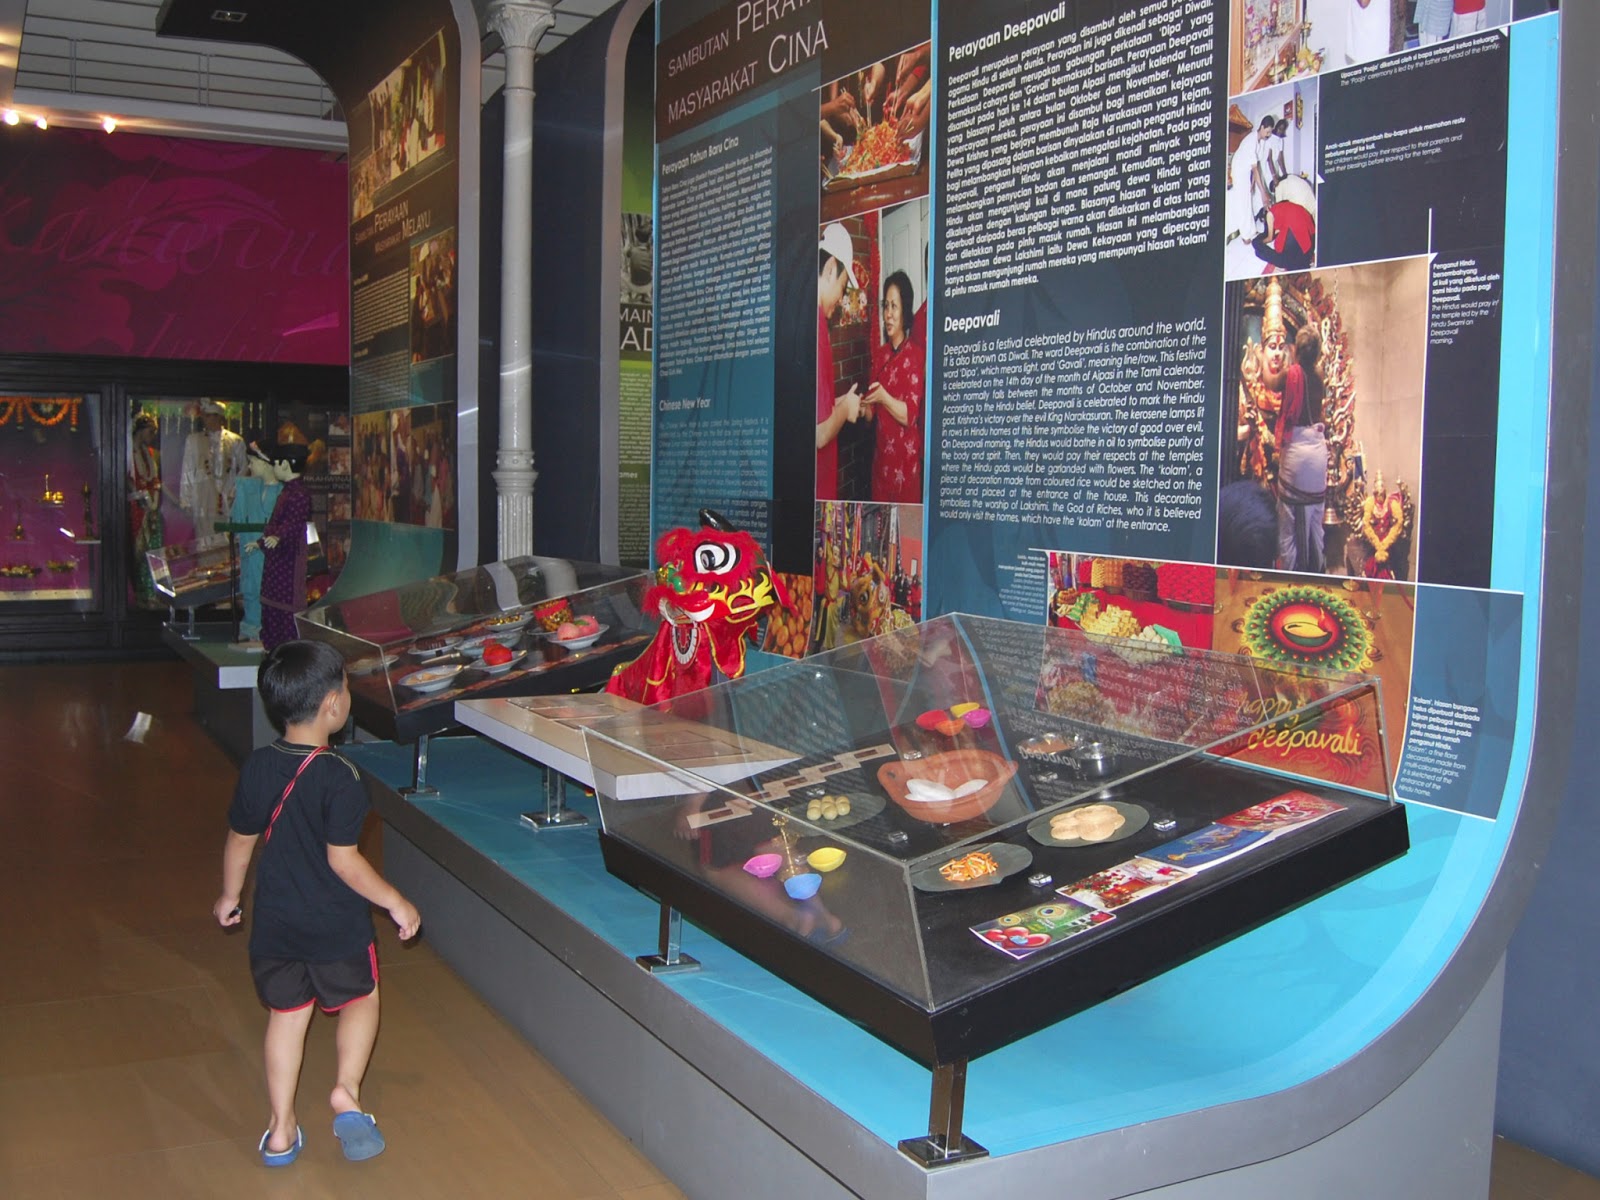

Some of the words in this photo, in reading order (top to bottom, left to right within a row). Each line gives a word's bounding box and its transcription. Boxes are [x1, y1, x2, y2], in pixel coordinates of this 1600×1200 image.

[668, 29, 729, 77] SAMBUTAN
[736, 0, 810, 40] PERA
[950, 32, 1000, 62] Perayaan
[1004, 2, 1065, 40] Deepavali
[668, 61, 758, 124] MASYARAKAT
[768, 20, 829, 73] CINA
[948, 93, 978, 108] Perkataan
[983, 78, 1015, 97] Deepavali
[1021, 65, 1060, 84] merupakan
[1066, 50, 1104, 71] gabungan
[1111, 33, 1152, 56] perkataan
[1191, 12, 1213, 29] yang
[948, 102, 981, 120] bermaksud
[983, 95, 1007, 109] cahaya
[1009, 90, 1022, 100] dan
[1052, 64, 1092, 86] bermaksud
[1095, 57, 1124, 72] barisan.
[1128, 43, 1166, 62] Perayaan
[1169, 24, 1213, 48] Deepavali
[947, 157, 964, 168] Dewa
[967, 150, 988, 162] Krishna
[991, 144, 1007, 157] yang
[1010, 136, 1036, 150] berjaya
[1039, 122, 1078, 141] membunuh
[1082, 117, 1099, 129] Raja
[1102, 103, 1152, 124] Narakasuran
[1156, 96, 1178, 111] yang
[1182, 87, 1211, 102] kejam.
[948, 138, 988, 155] kepercayaan
[991, 129, 1017, 143] mereka,
[1021, 118, 1053, 136] perayaan
[1068, 102, 1103, 120] disambut
[1107, 95, 1124, 109] bagi
[1128, 85, 1166, 103] meraikan
[1171, 71, 1212, 90] kejayaan
[662, 158, 689, 175] Perayaan
[690, 150, 707, 164] Tahun
[709, 143, 722, 157] Baru
[724, 136, 738, 150] Cina
[375, 200, 408, 234] PERAYAAN
[402, 209, 431, 240] MELAYU
[946, 224, 982, 238] dikalungkan
[986, 218, 1011, 229] dengan
[1016, 210, 1047, 222] kalungan
[1051, 204, 1076, 215] bunga.
[1081, 195, 1115, 209] Biasanya
[1120, 189, 1146, 201] hiasan
[1188, 175, 1210, 189] yang
[944, 341, 980, 357] Deepavali
[982, 341, 987, 350] is
[996, 337, 1023, 348] festival
[1025, 332, 1071, 346] celebrated
[1073, 331, 1084, 344] by
[1086, 328, 1116, 339] Hindus
[1118, 323, 1153, 336] around
[1156, 322, 1172, 332] the
[1176, 317, 1206, 330] world.
[945, 310, 1000, 333] Deepavali
[659, 400, 681, 411] Chinese
[682, 398, 696, 410] New
[696, 397, 711, 408] Year
[964, 391, 989, 401] normally
[993, 390, 1004, 399] falls
[1008, 389, 1037, 398] between
[1042, 387, 1053, 396] the
[1057, 385, 1082, 395] months
[1086, 384, 1095, 394] of
[1099, 383, 1132, 393] October
[1136, 381, 1153, 391] and
[1157, 379, 1205, 390] November.
[974, 463, 992, 472] Hindu
[994, 464, 1010, 474] gods
[1013, 464, 1033, 472] would
[1036, 464, 1045, 473] be
[1048, 464, 1086, 475] garlanded
[1089, 464, 1104, 473] with
[1108, 464, 1136, 474] flowers.
[1140, 464, 1154, 474] The
[1248, 725, 1362, 756] deepavali
